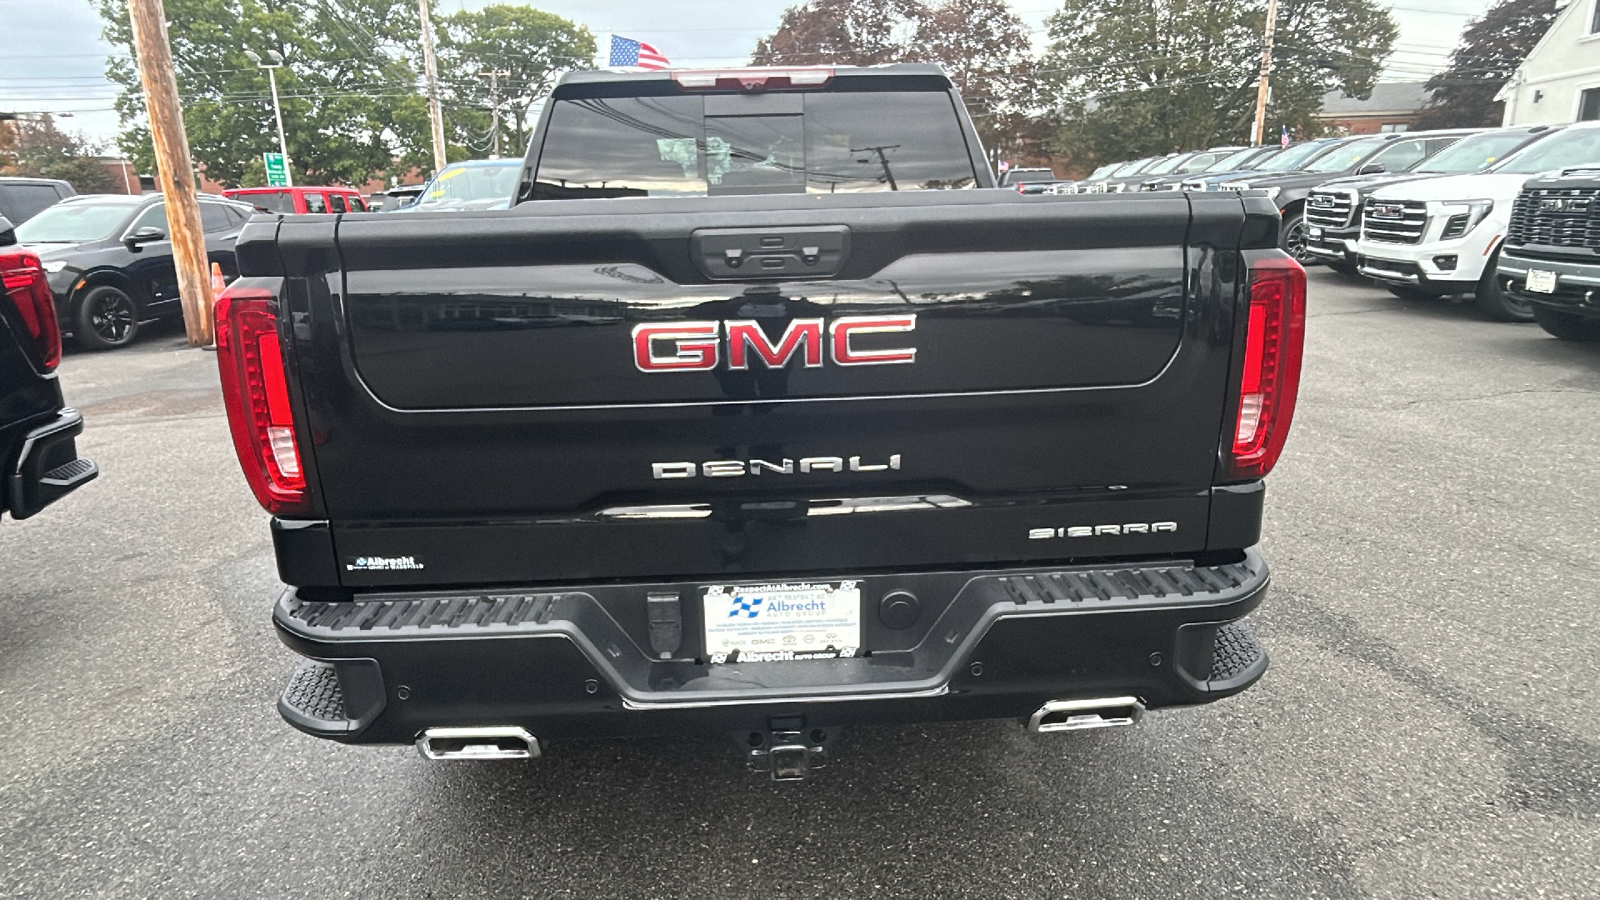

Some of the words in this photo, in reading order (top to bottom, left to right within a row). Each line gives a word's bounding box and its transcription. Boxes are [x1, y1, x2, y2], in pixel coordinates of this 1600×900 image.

[1540, 199, 1589, 212] GMC
[631, 314, 917, 373] GMC
[652, 454, 900, 479] DENALI
[1028, 521, 1177, 539] SIERRA
[366, 556, 415, 566] Albrecht
[766, 600, 826, 612] Albrecht
[736, 651, 795, 663] Albrecht
